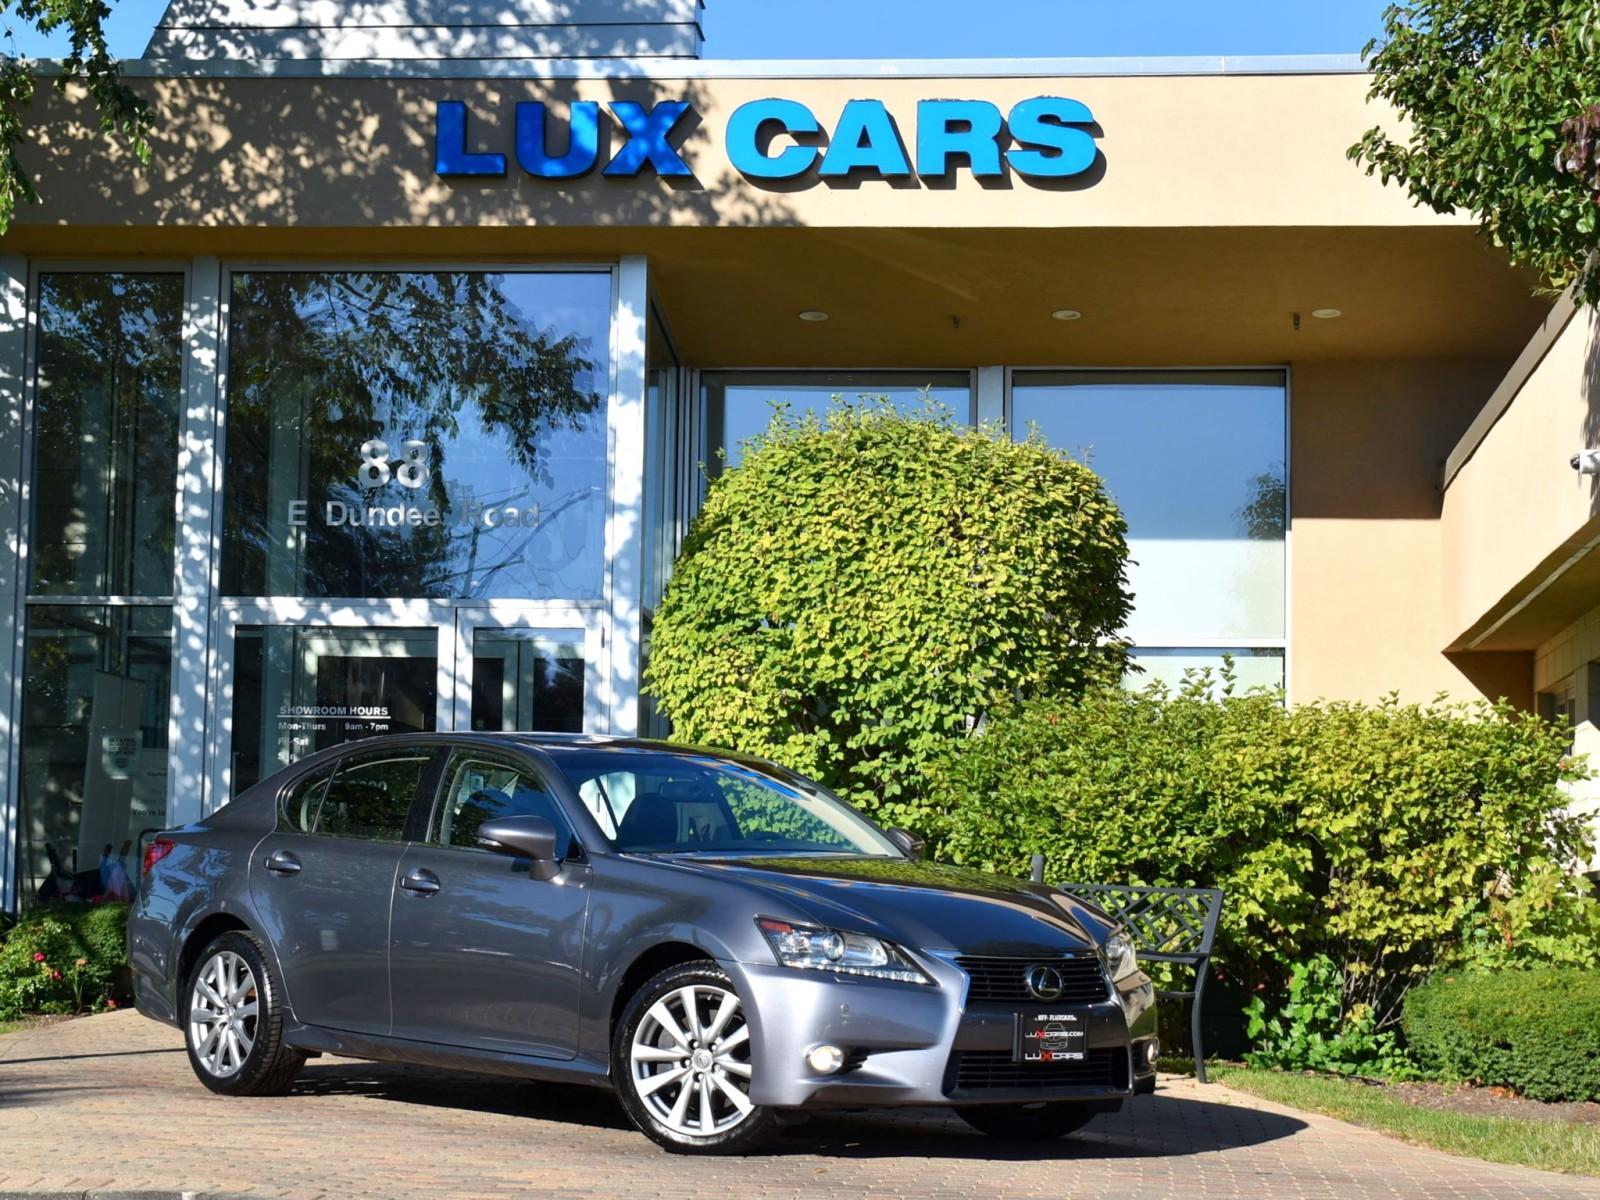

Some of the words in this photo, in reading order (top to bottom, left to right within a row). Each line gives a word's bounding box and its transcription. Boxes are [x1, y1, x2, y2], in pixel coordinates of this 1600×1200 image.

[435, 100, 694, 178] LUX
[724, 97, 1104, 179] CARS
[358, 439, 430, 489] 88
[288, 500, 308, 525] E
[326, 500, 441, 527] Dundee
[461, 502, 540, 528] Road
[279, 706, 347, 716] SHOWROOM
[349, 706, 389, 716] HOURS
[278, 722, 327, 731] Mon-Thurs
[344, 722, 363, 731] 9am
[370, 722, 389, 732] 7pm
